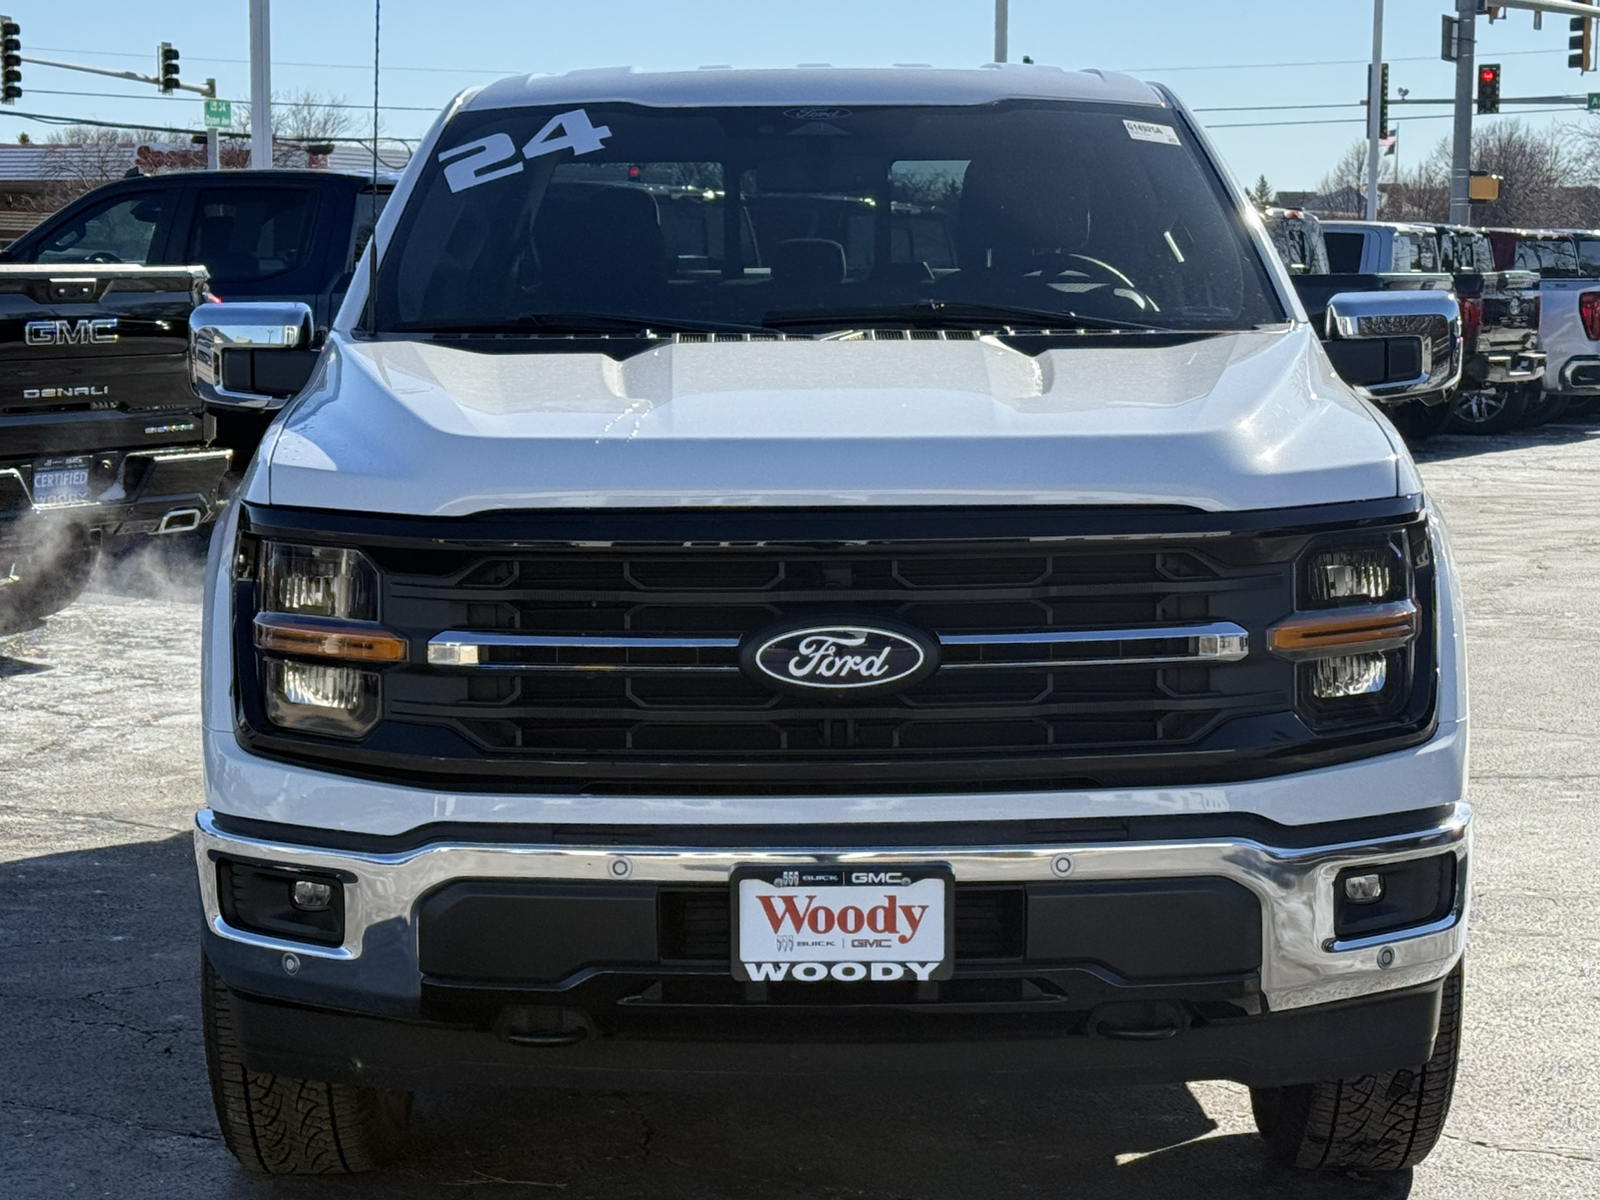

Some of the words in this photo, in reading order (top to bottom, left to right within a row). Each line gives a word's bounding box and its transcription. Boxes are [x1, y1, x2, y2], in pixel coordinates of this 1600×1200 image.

[796, 108, 840, 119] Ford
[438, 108, 612, 193] 24
[25, 319, 118, 345] GMC
[23, 385, 109, 399] DENALI
[34, 471, 88, 488] CERTIFIED
[788, 634, 892, 677] Ford
[851, 872, 902, 884] GMC
[756, 895, 929, 944] Woody
[851, 938, 892, 948] GMC
[744, 962, 940, 982] WOODY
